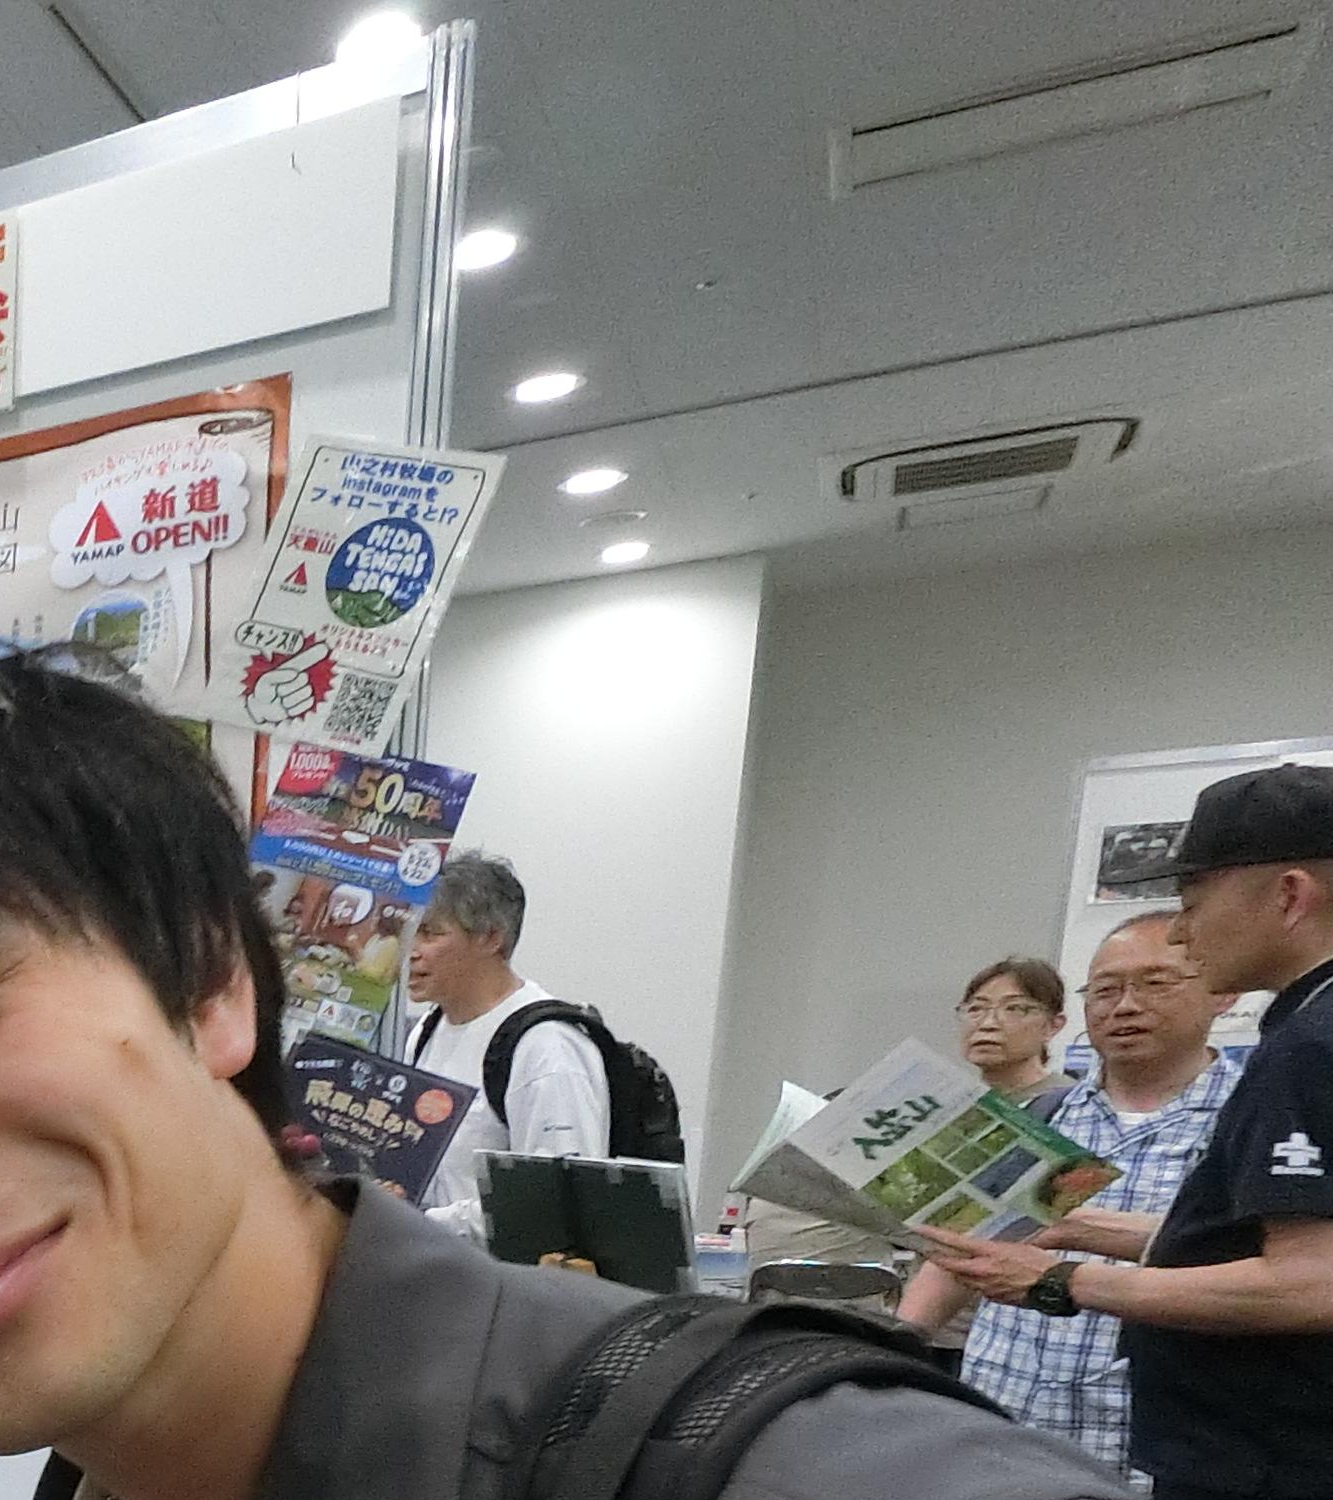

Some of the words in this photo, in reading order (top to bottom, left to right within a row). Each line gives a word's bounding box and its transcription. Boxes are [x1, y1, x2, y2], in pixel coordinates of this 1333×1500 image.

[142, 476, 221, 524] 新道
[71, 544, 125, 566] YAMAP
[131, 514, 229, 555] OPEN!!
